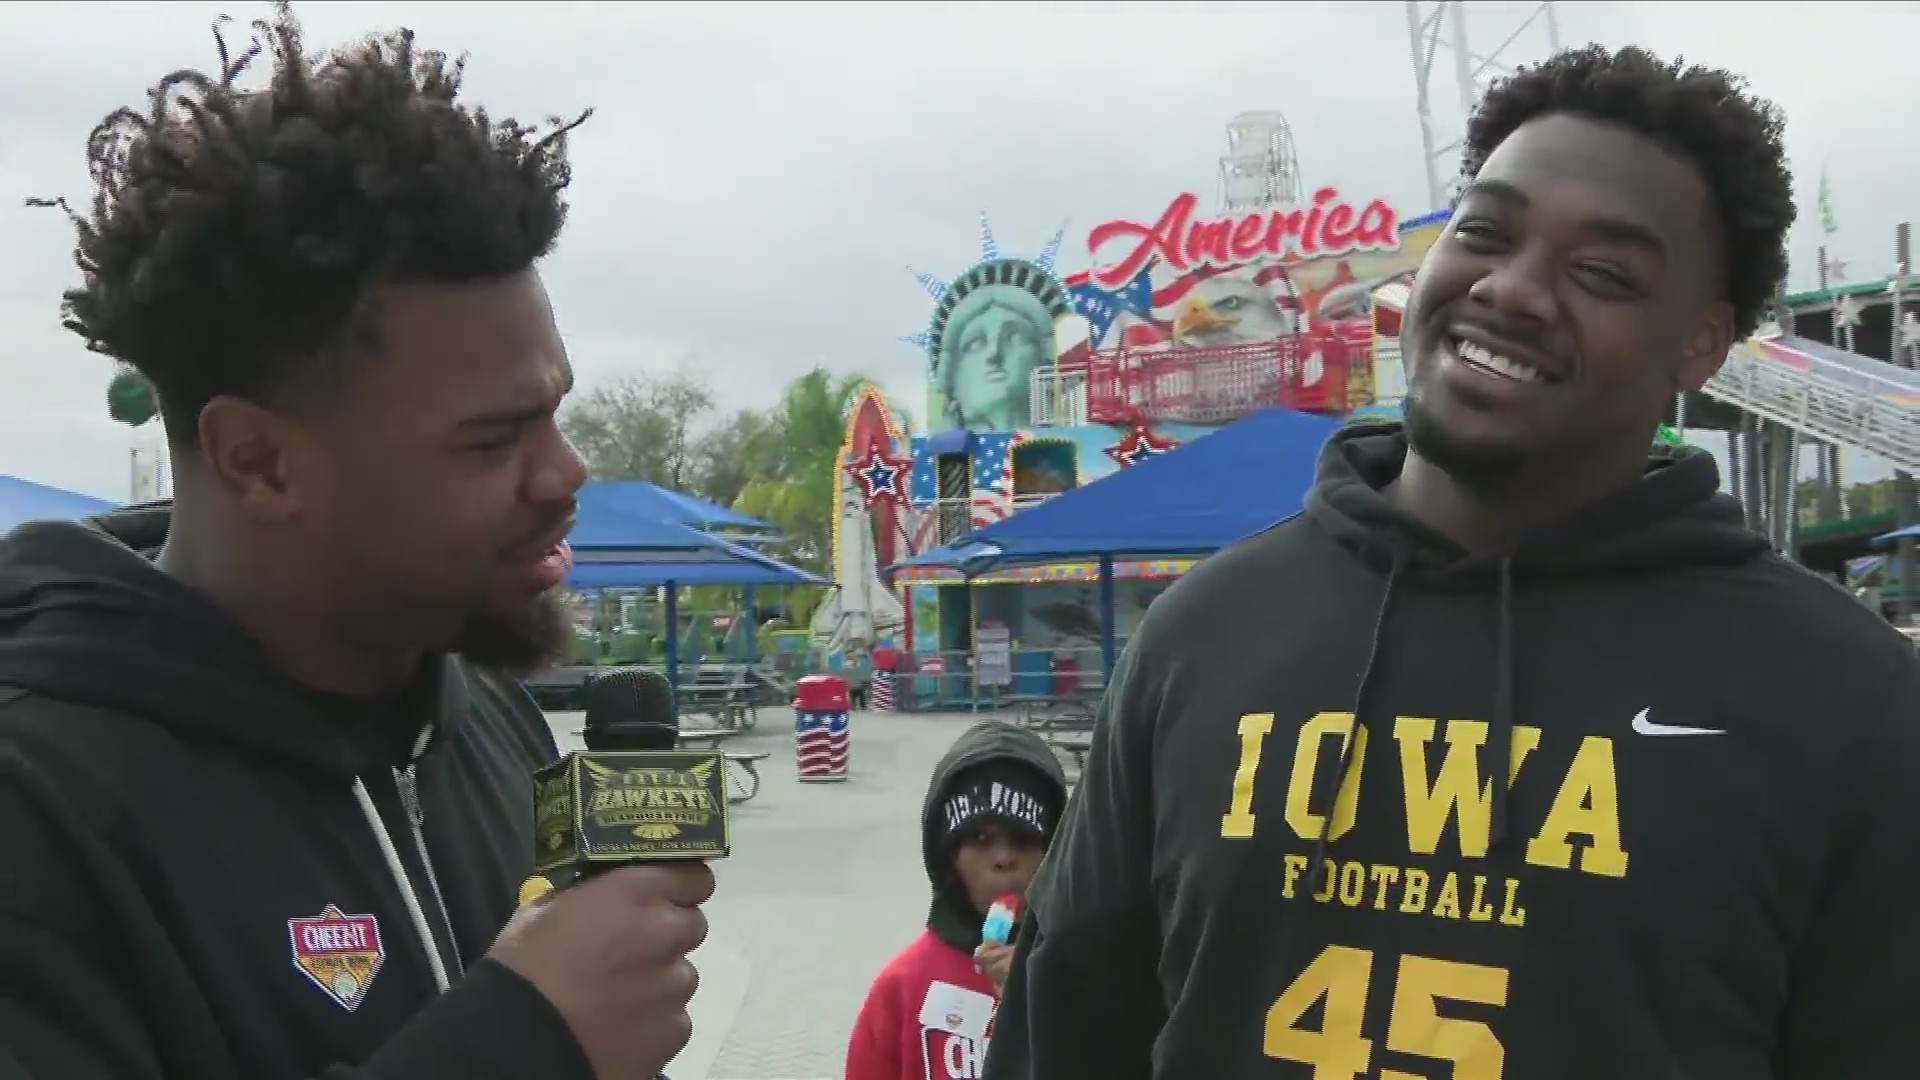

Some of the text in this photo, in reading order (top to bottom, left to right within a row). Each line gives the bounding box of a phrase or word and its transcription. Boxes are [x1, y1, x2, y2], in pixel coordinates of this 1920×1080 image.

[1086, 185, 1397, 287] America
[593, 788, 712, 811] HAWKEYE
[1221, 711, 1629, 878] IOWA
[1281, 854, 1526, 927] FOOTBALL
[1263, 944, 1509, 1080] 45
